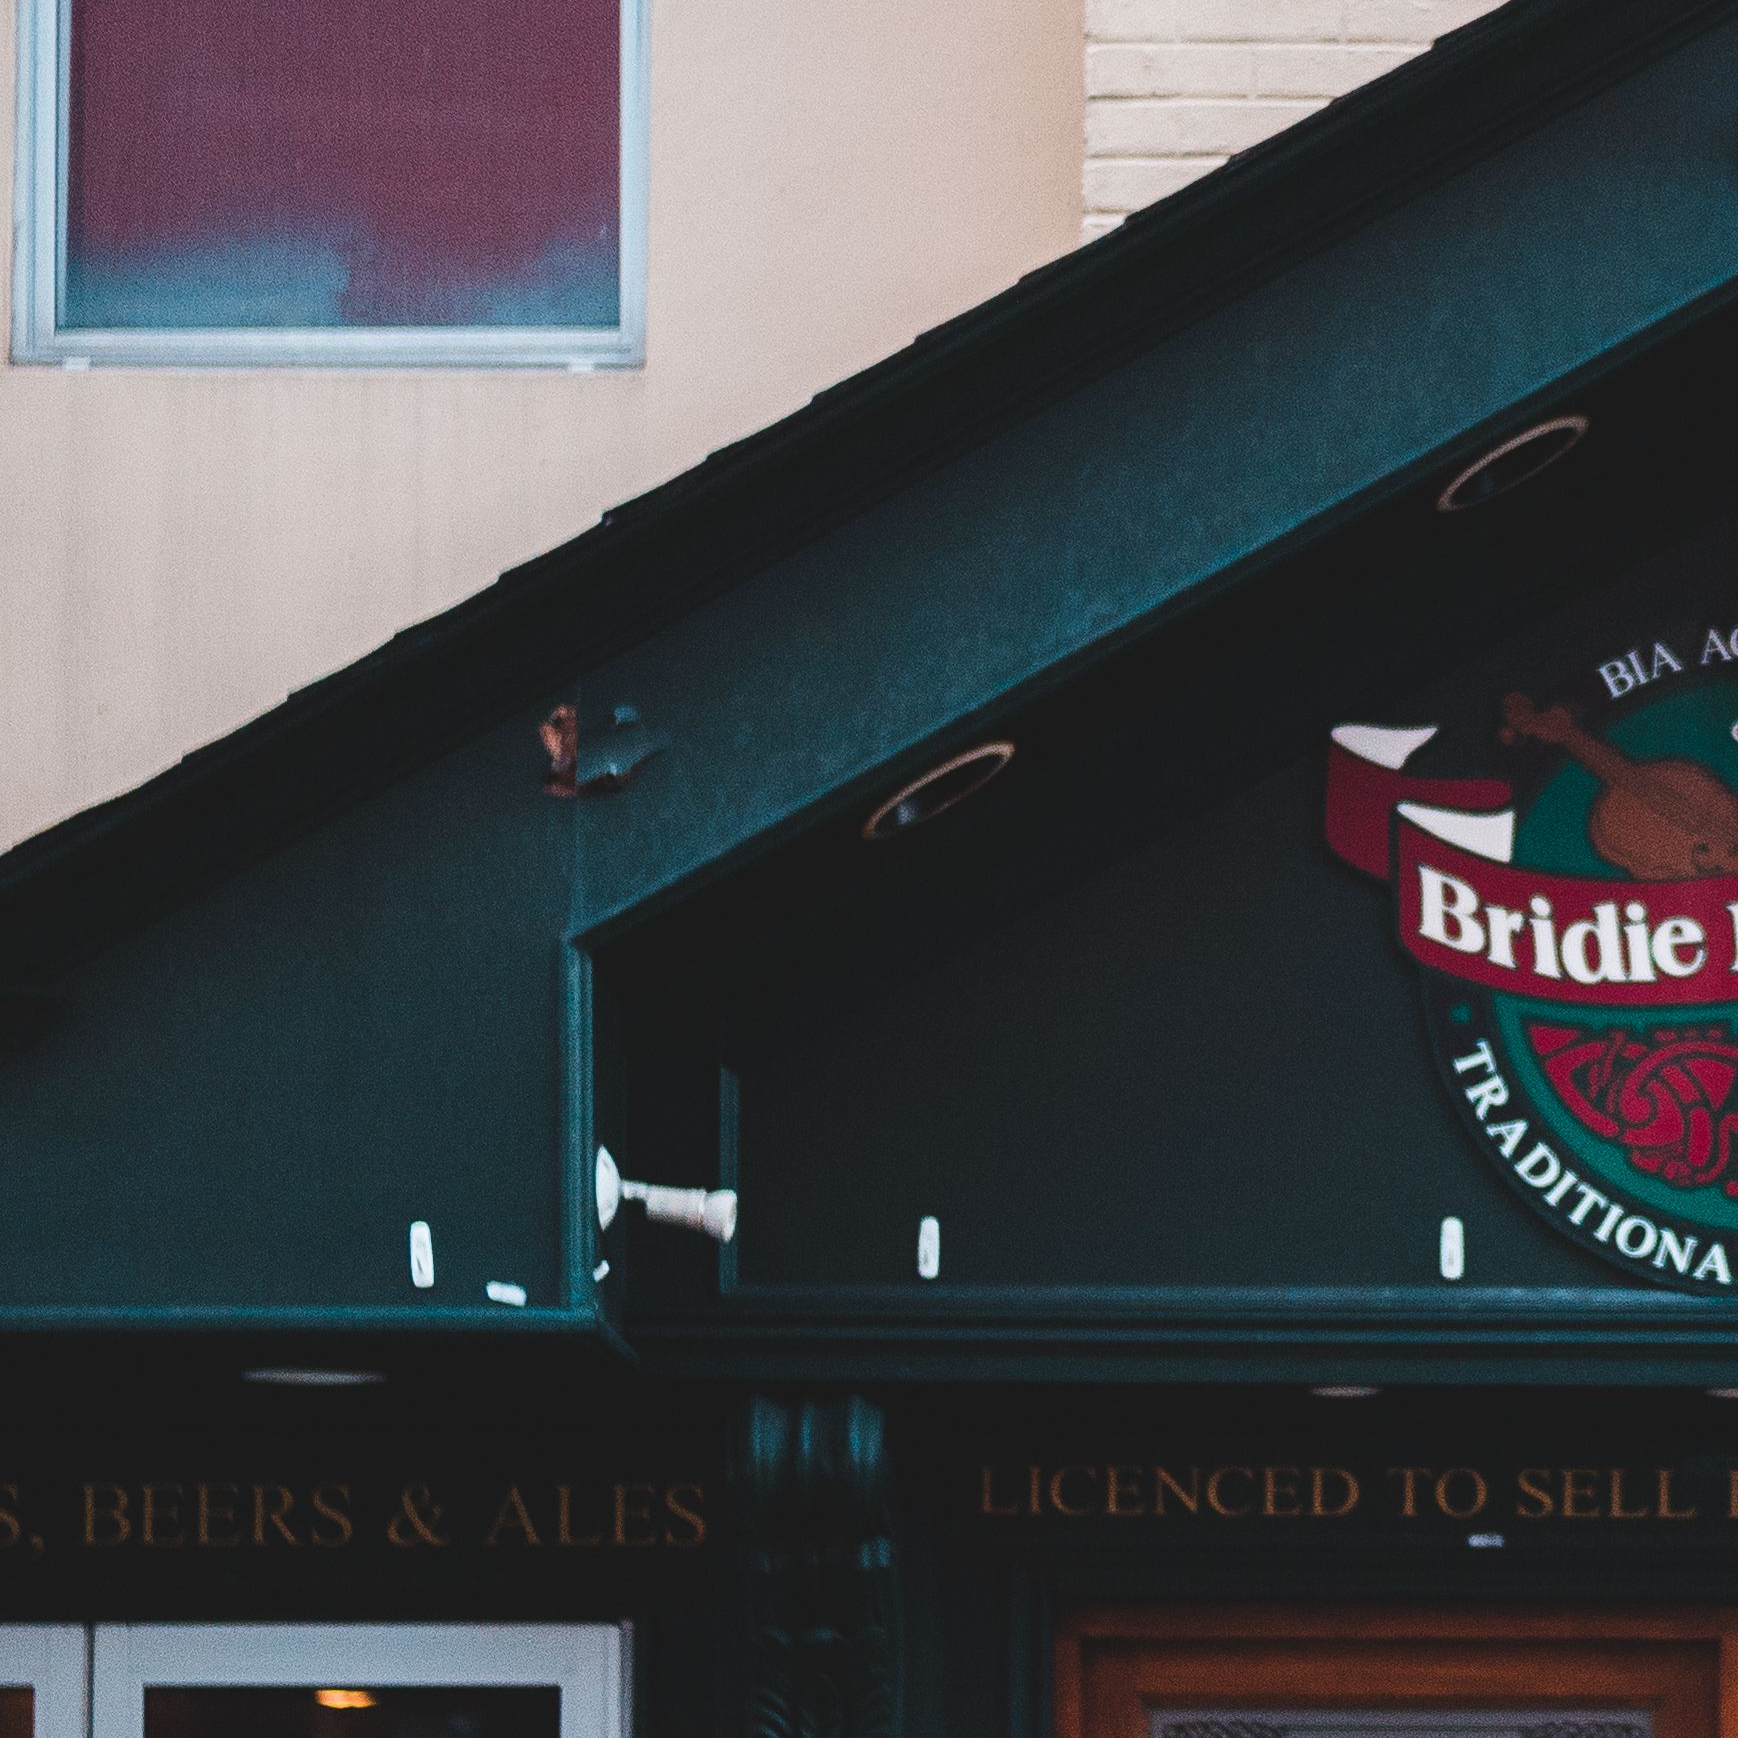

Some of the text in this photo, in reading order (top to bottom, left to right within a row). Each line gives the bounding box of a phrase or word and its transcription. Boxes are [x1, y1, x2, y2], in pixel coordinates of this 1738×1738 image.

[1599, 640, 1683, 701] BIA
[1416, 863, 1707, 985] Bridie
[81, 1482, 355, 1547] BEERS
[386, 1482, 451, 1547] &
[482, 1482, 707, 1548] ALES
[979, 1466, 1361, 1519] LICENCED
[1387, 1466, 1490, 1519] TO
[1514, 1467, 1698, 1520] SELL
